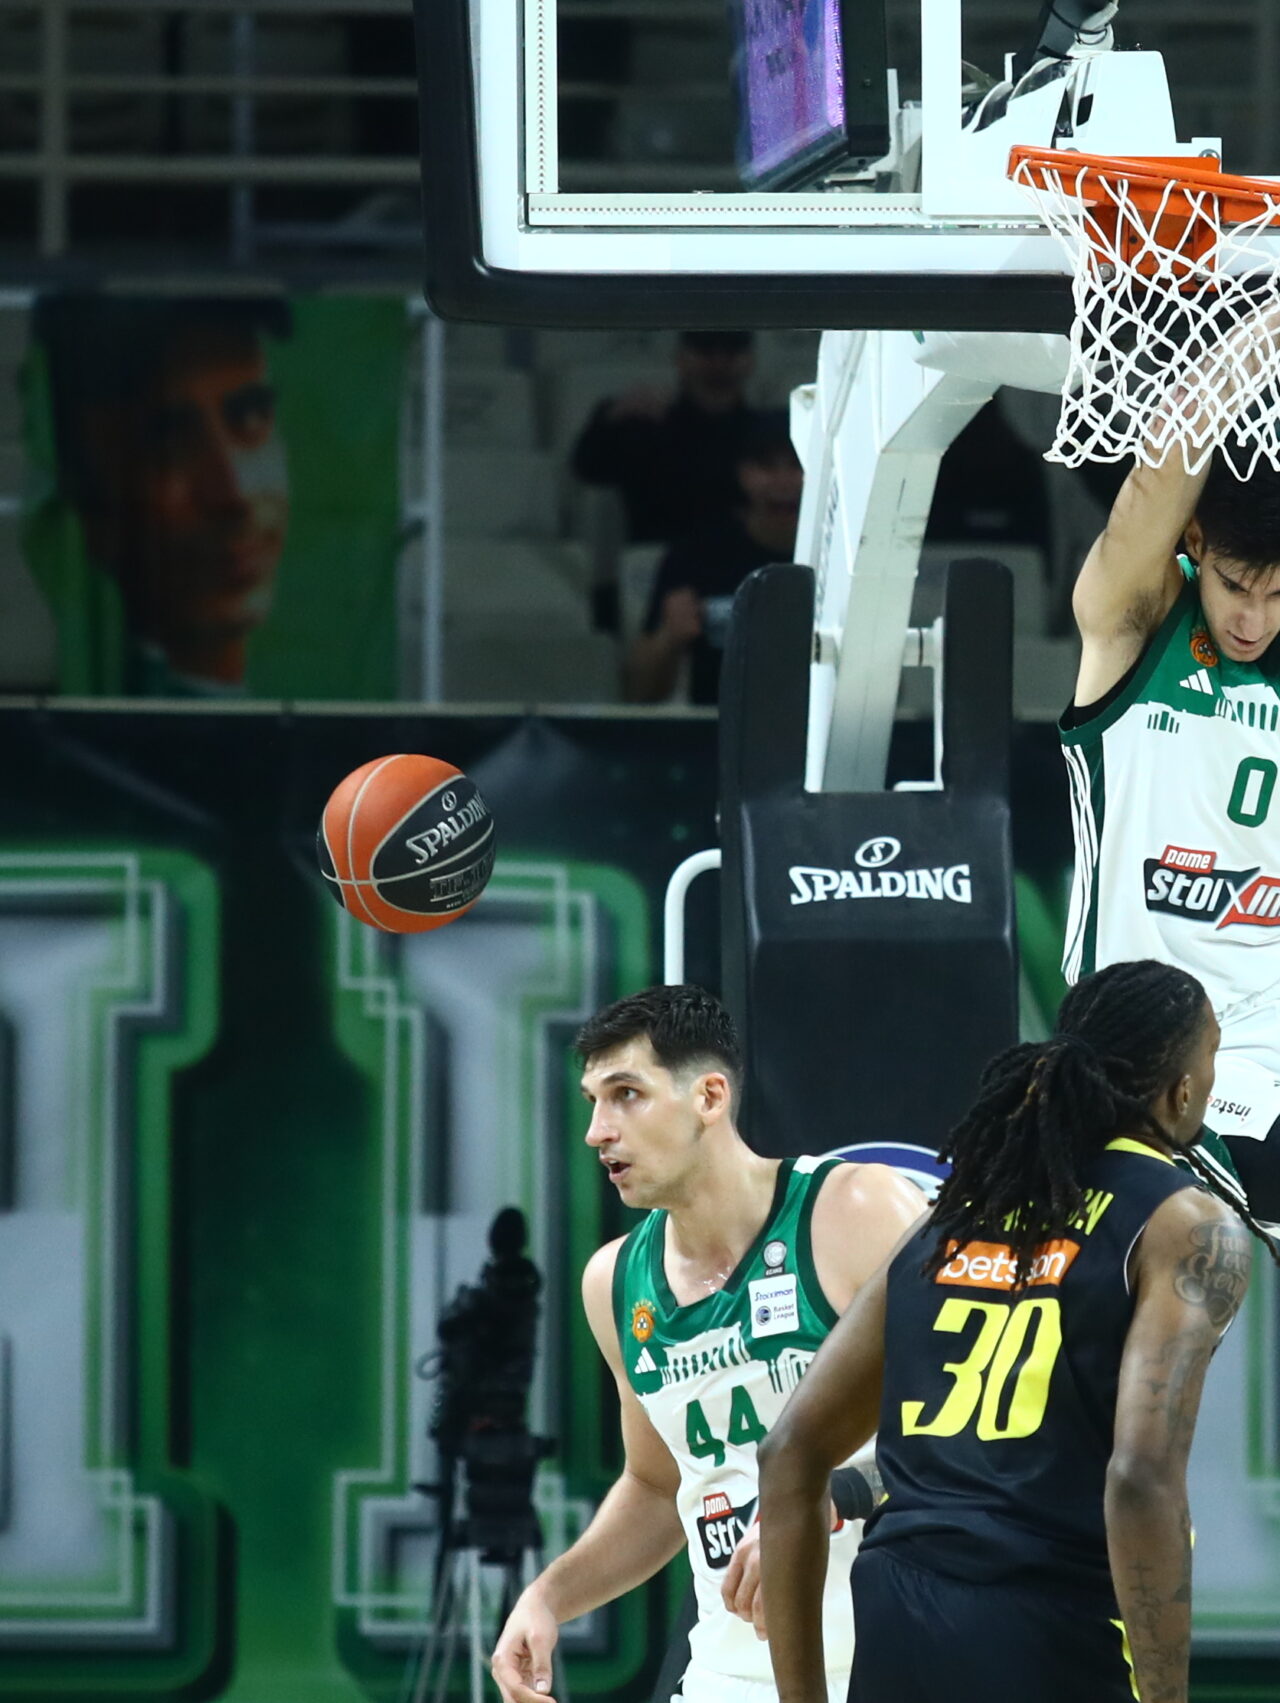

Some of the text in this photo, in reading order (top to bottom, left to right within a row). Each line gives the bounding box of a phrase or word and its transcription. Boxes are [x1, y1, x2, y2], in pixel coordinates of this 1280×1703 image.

[405, 789, 491, 864] SPALDIN
[1226, 756, 1278, 828] 0
[788, 864, 972, 905] SPALDING
[1164, 849, 1211, 869] pame
[901, 1297, 1062, 1441] 30
[685, 1385, 768, 1468] 44
